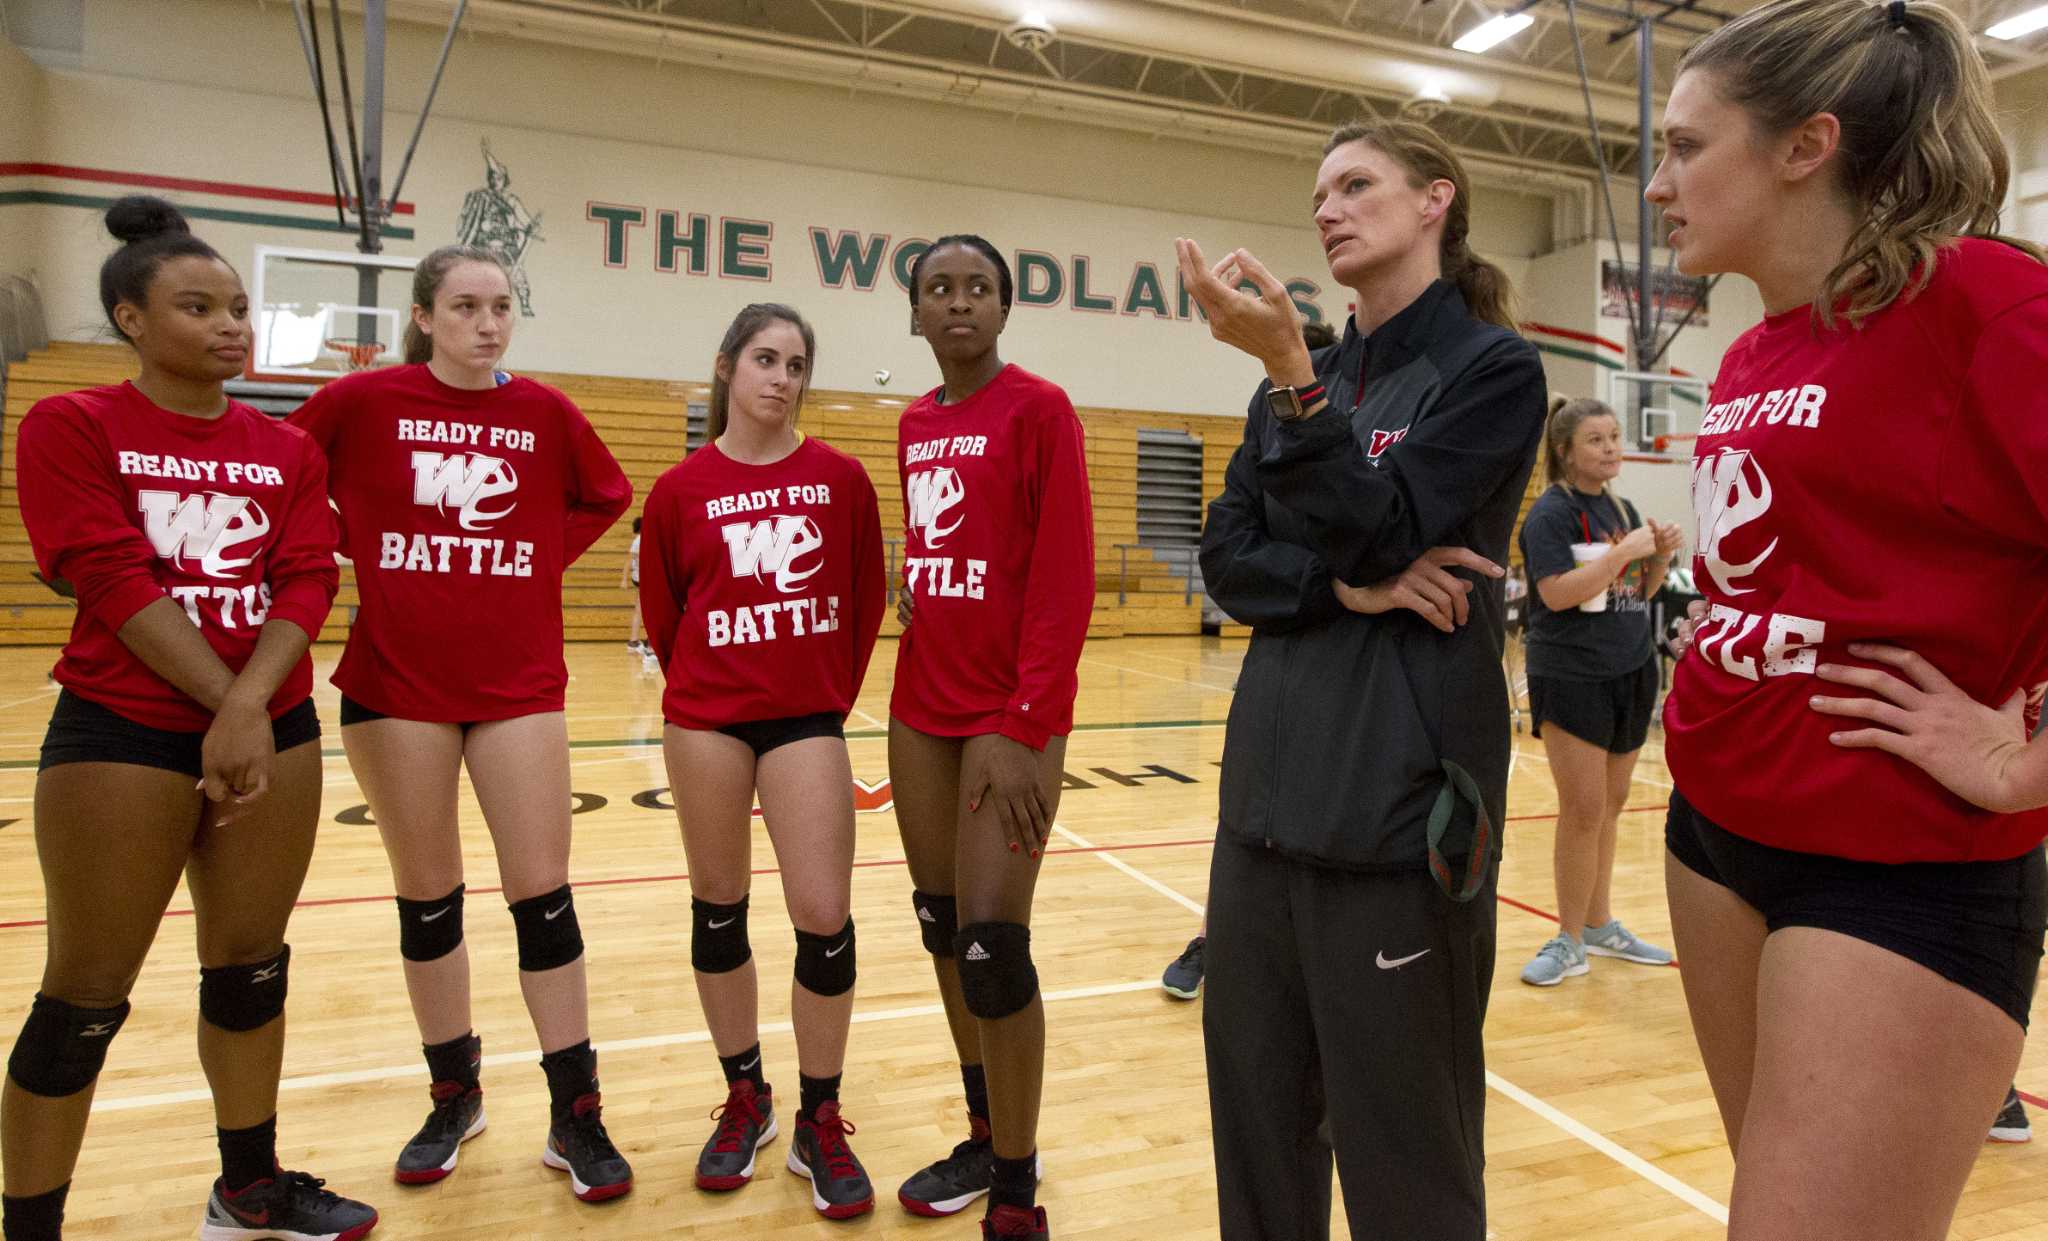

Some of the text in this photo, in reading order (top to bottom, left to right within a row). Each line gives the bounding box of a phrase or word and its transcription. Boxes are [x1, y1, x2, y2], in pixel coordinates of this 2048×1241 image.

[586, 201, 773, 282] THE
[1697, 384, 1827, 436] EADY FOR
[398, 419, 535, 452] READY FOR
[906, 436, 987, 466] READY FOR
[118, 451, 284, 486] READY FOR
[706, 484, 831, 520] READY FOR
[379, 532, 534, 577] BATTLE
[906, 557, 988, 600] TTLE
[707, 596, 839, 647] BATTLE
